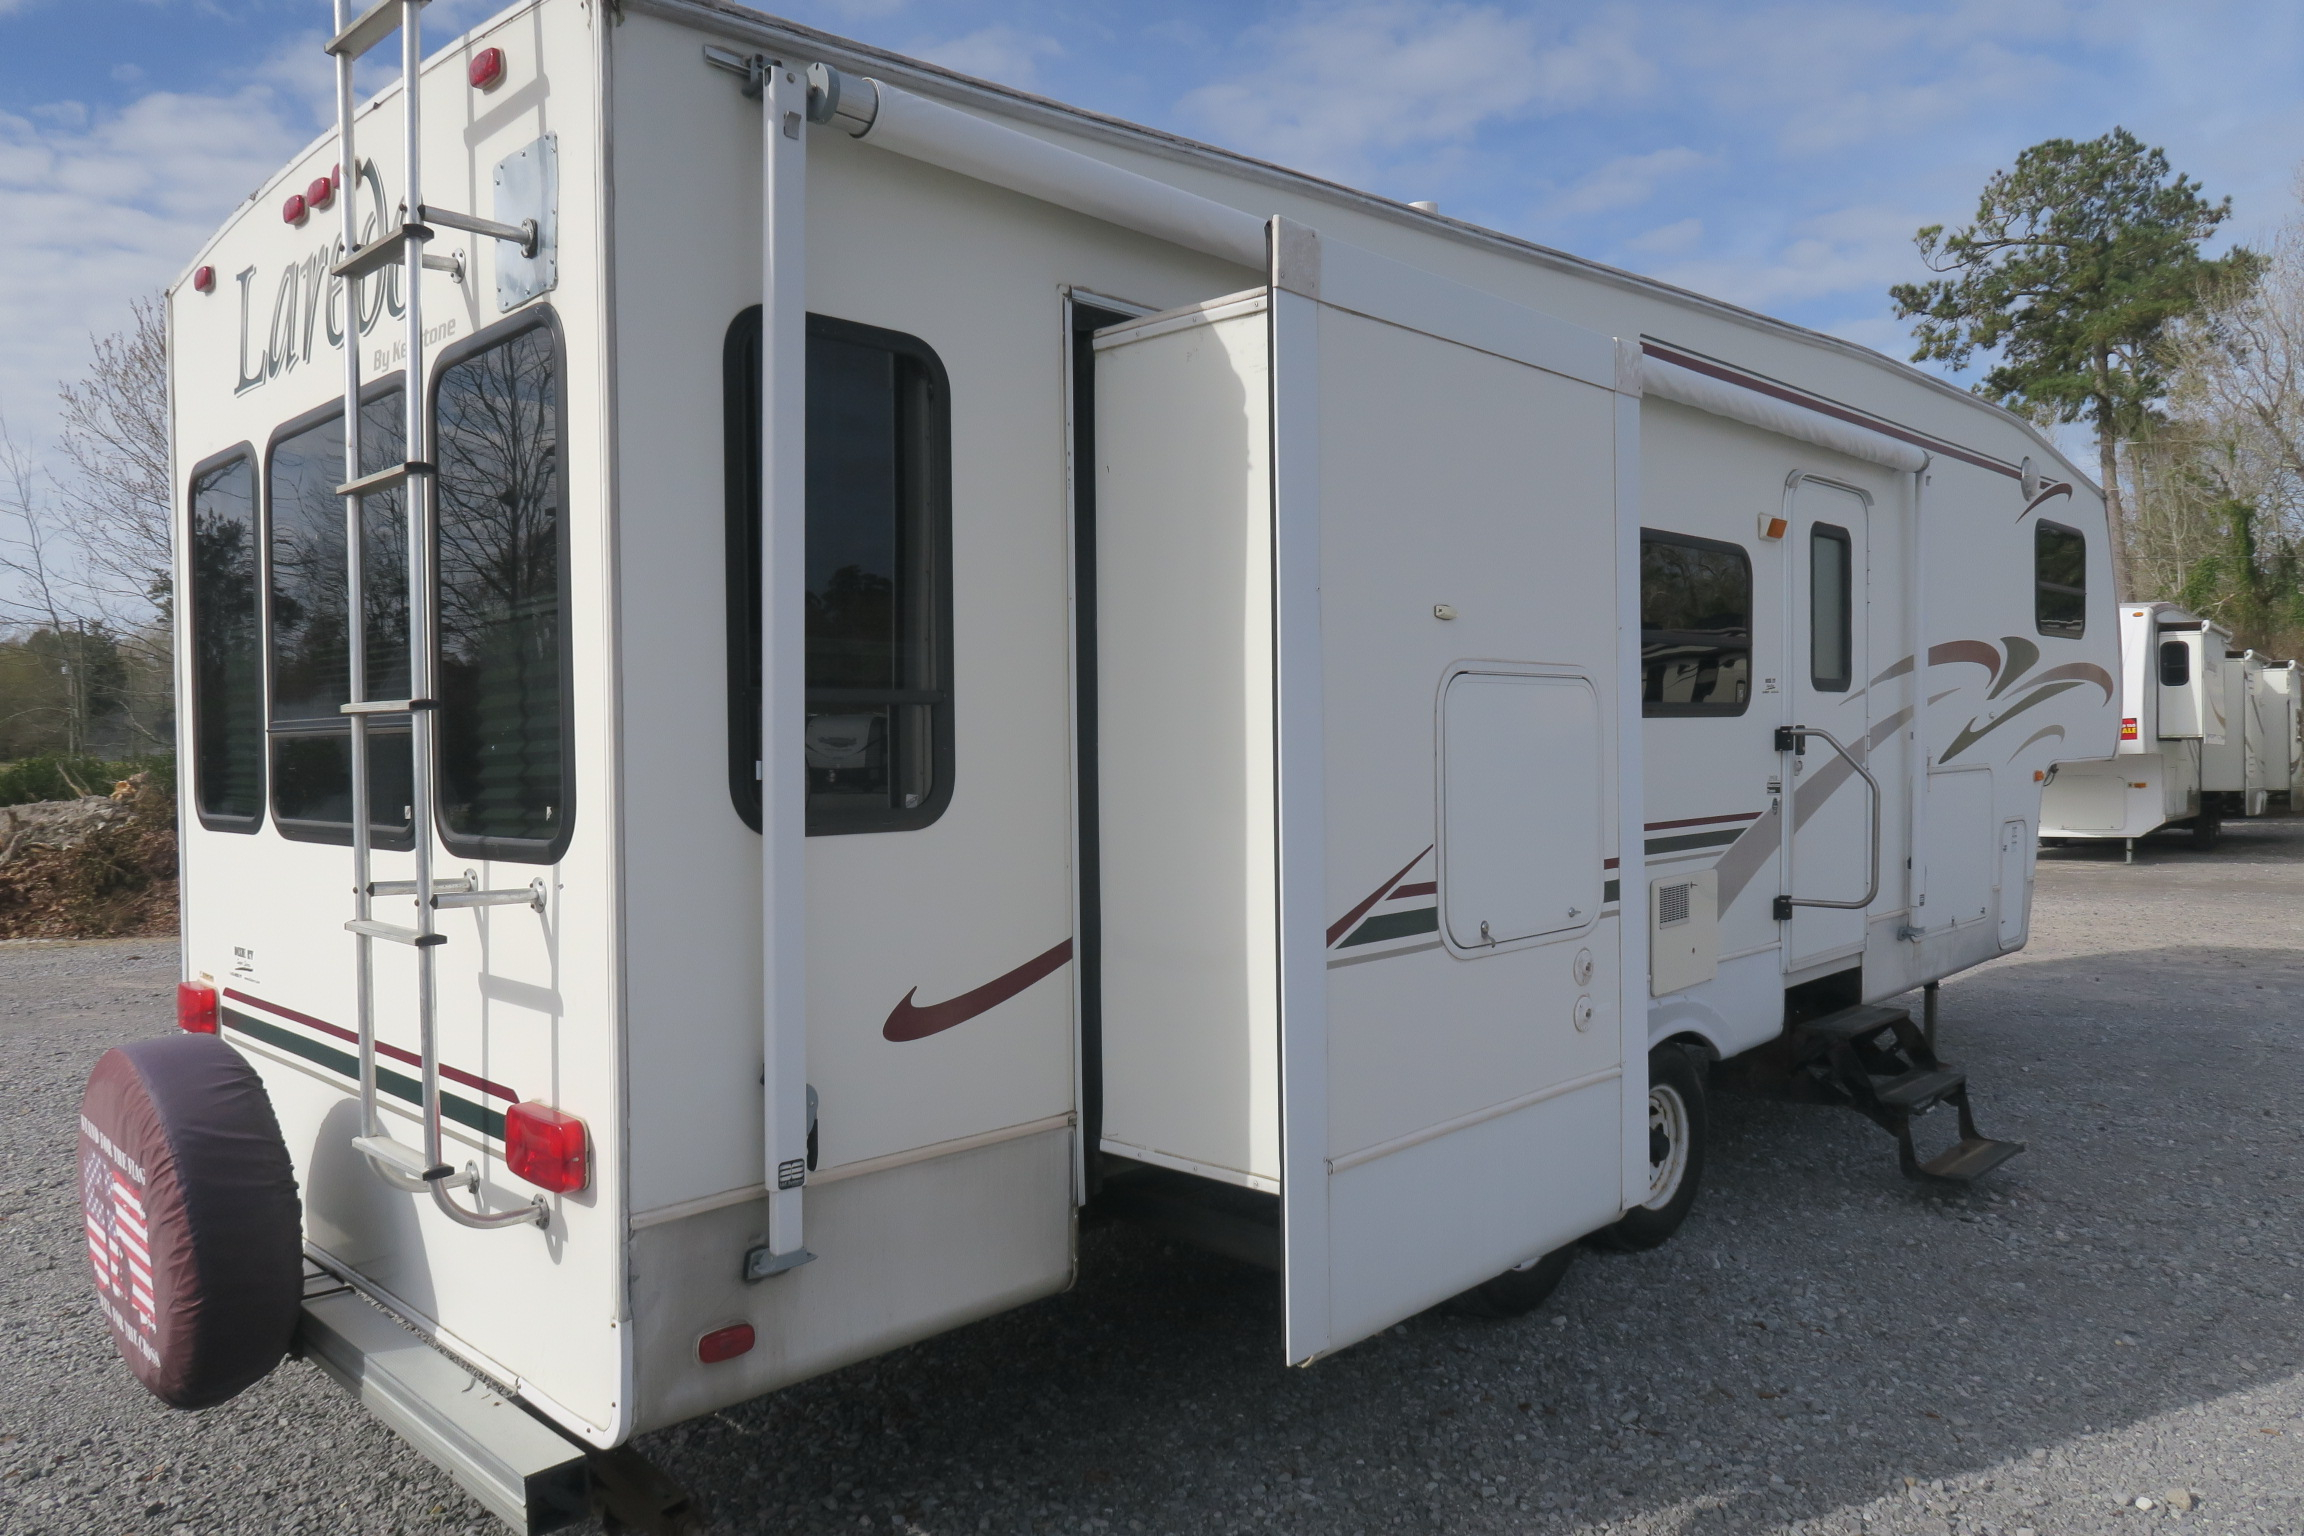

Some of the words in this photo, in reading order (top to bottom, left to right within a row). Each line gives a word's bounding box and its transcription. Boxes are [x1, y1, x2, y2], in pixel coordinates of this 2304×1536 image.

[374, 348, 390, 373] By
[392, 318, 456, 362] Ketone
[99, 1131, 113, 1158] FOR
[112, 1144, 128, 1171] THE
[127, 1157, 146, 1186] FLAG
[123, 1319, 138, 1346] THE
